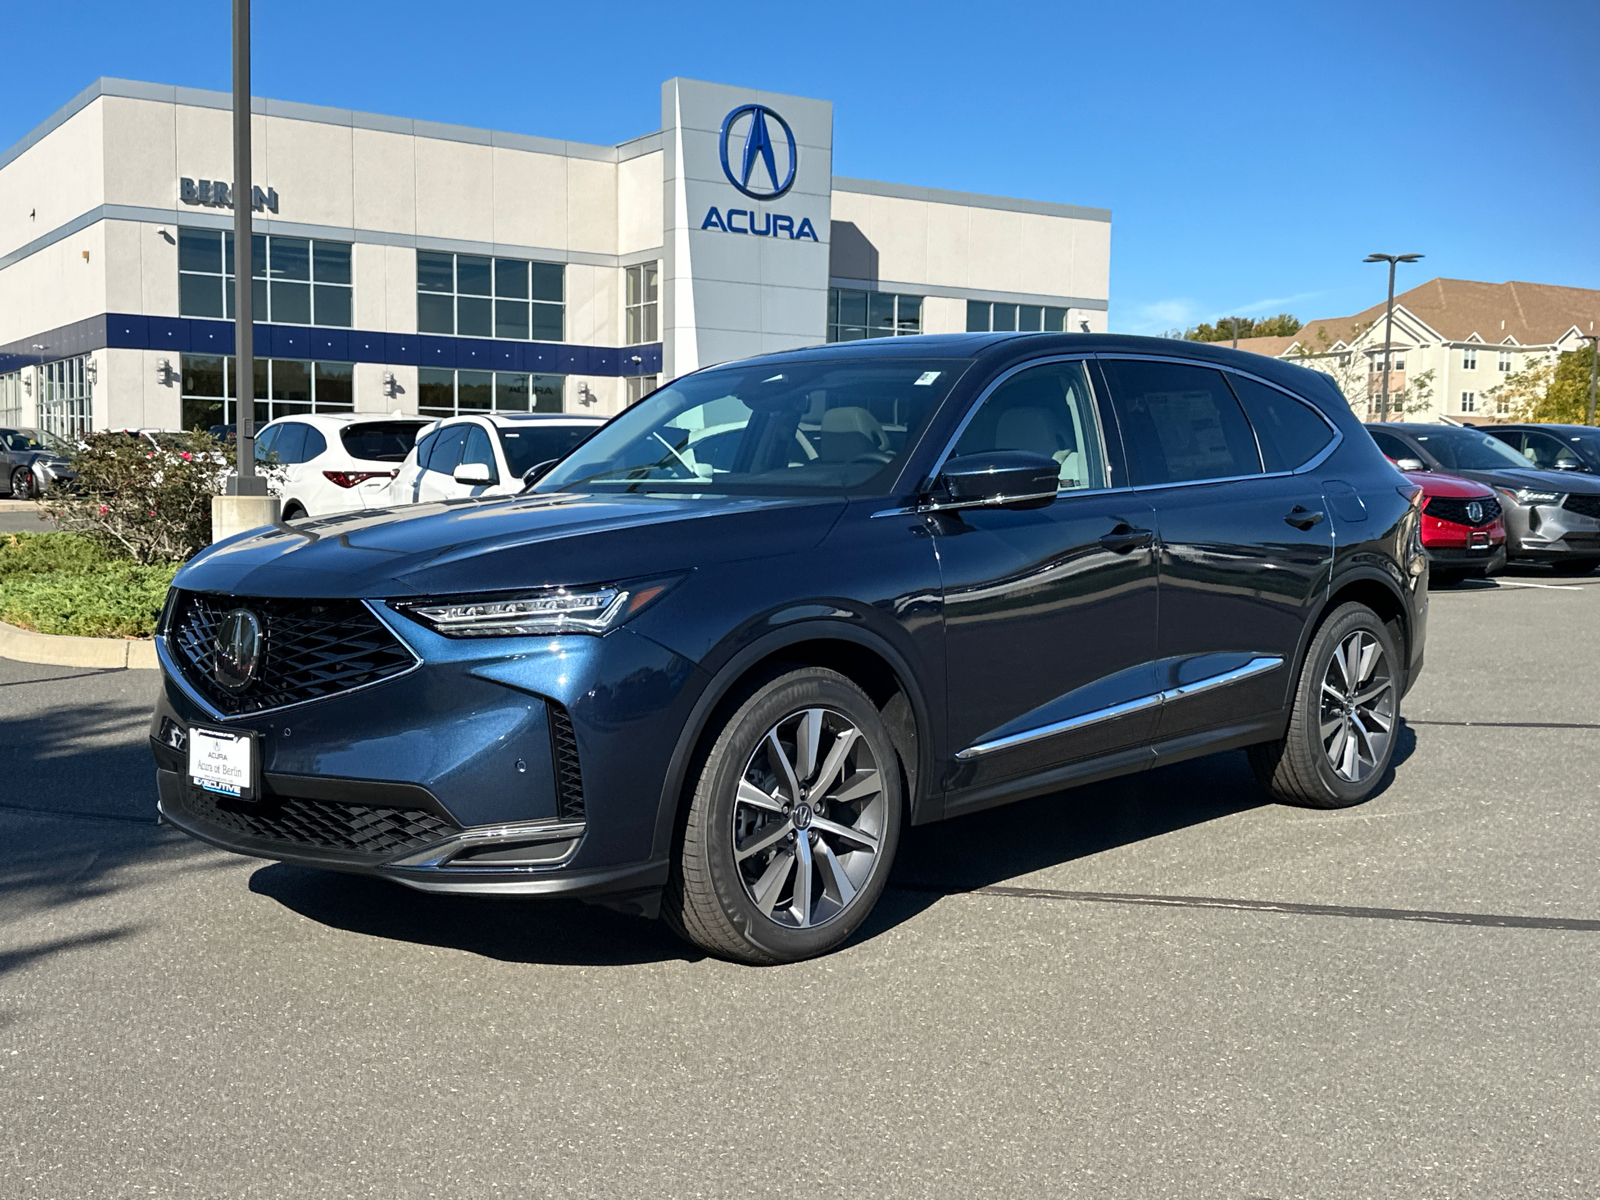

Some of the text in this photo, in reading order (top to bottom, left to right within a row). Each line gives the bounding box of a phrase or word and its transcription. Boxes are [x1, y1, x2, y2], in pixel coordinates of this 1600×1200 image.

[180, 176, 278, 212] BERN
[701, 206, 819, 242] ACURA
[197, 760, 212, 772] Acura
[222, 764, 241, 777] Berlin
[208, 752, 228, 761] ACURA
